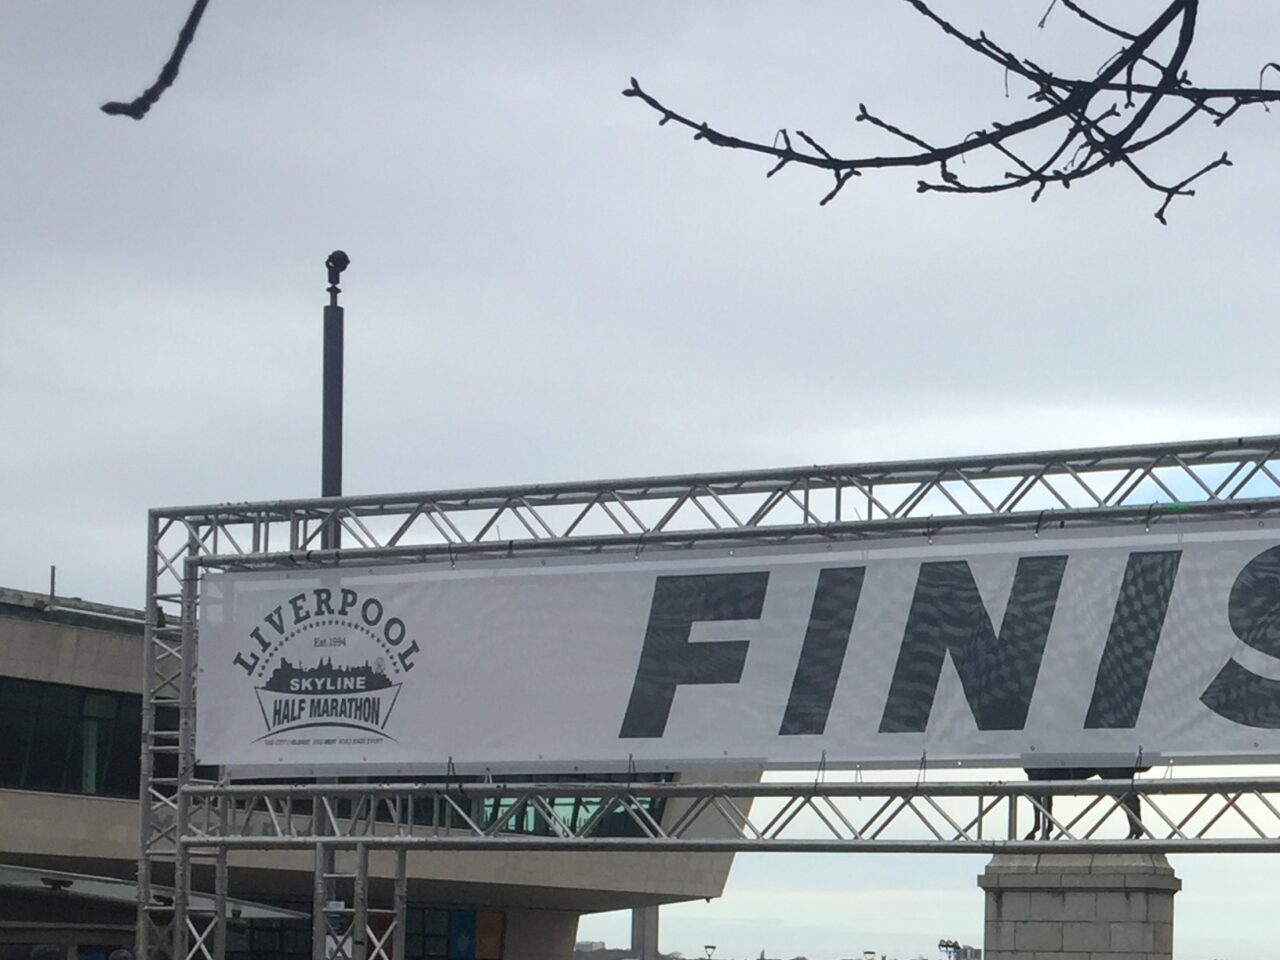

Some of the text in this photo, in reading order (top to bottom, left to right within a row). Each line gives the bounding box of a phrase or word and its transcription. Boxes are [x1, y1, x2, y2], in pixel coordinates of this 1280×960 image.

[233, 588, 420, 676] LIVERPOOL
[289, 676, 367, 691] SKYLINE
[272, 697, 381, 728] HALF MARATHON
